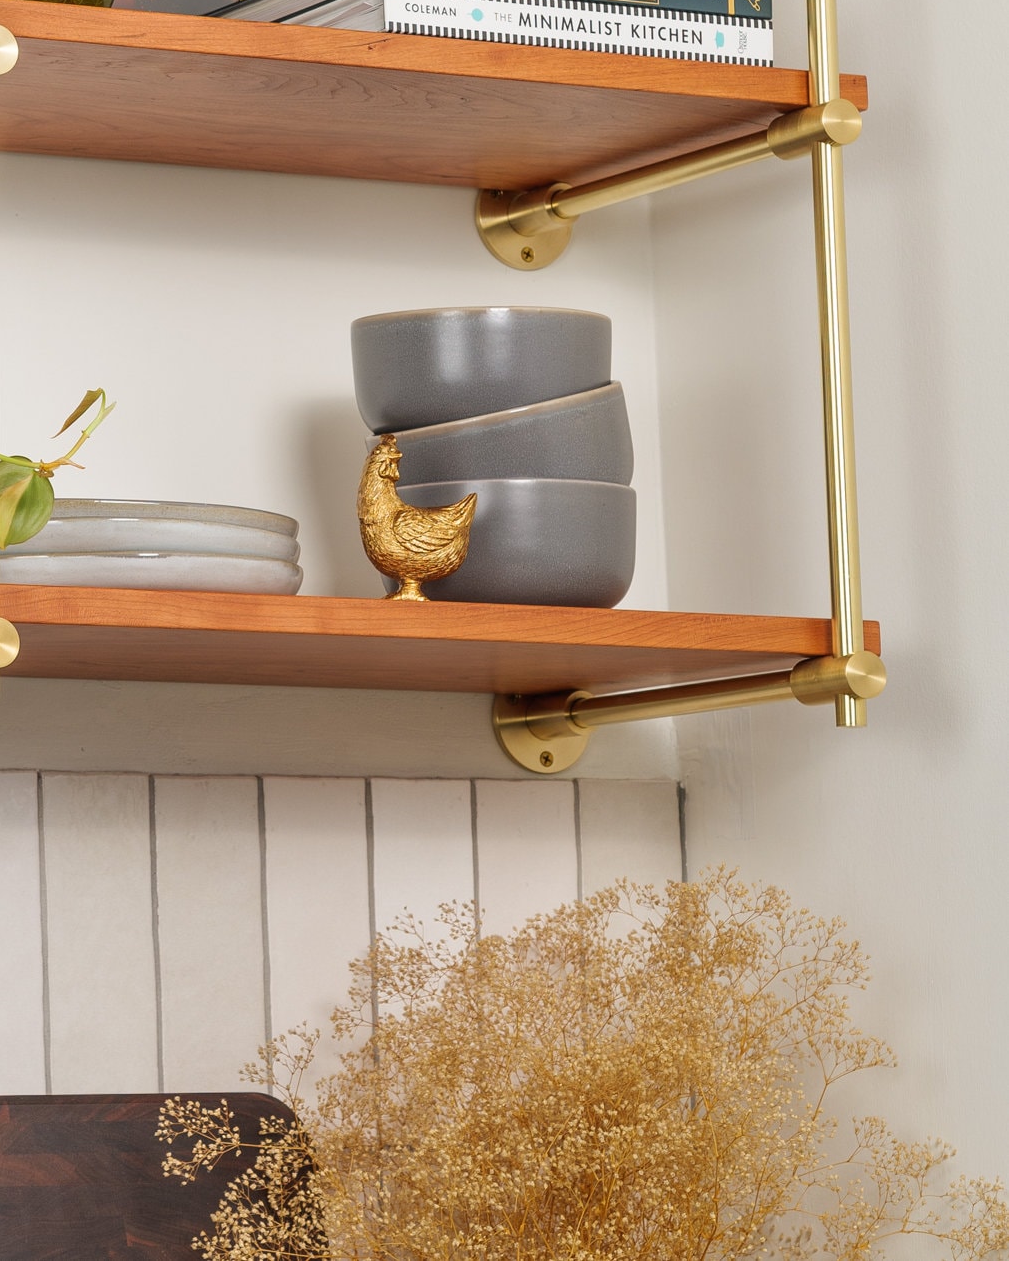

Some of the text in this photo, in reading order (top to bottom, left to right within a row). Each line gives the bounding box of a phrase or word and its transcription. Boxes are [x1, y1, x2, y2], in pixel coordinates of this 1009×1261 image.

[405, 2, 457, 17] COLEMAN
[494, 12, 703, 45] THE MINIMALIST KITCHEN
